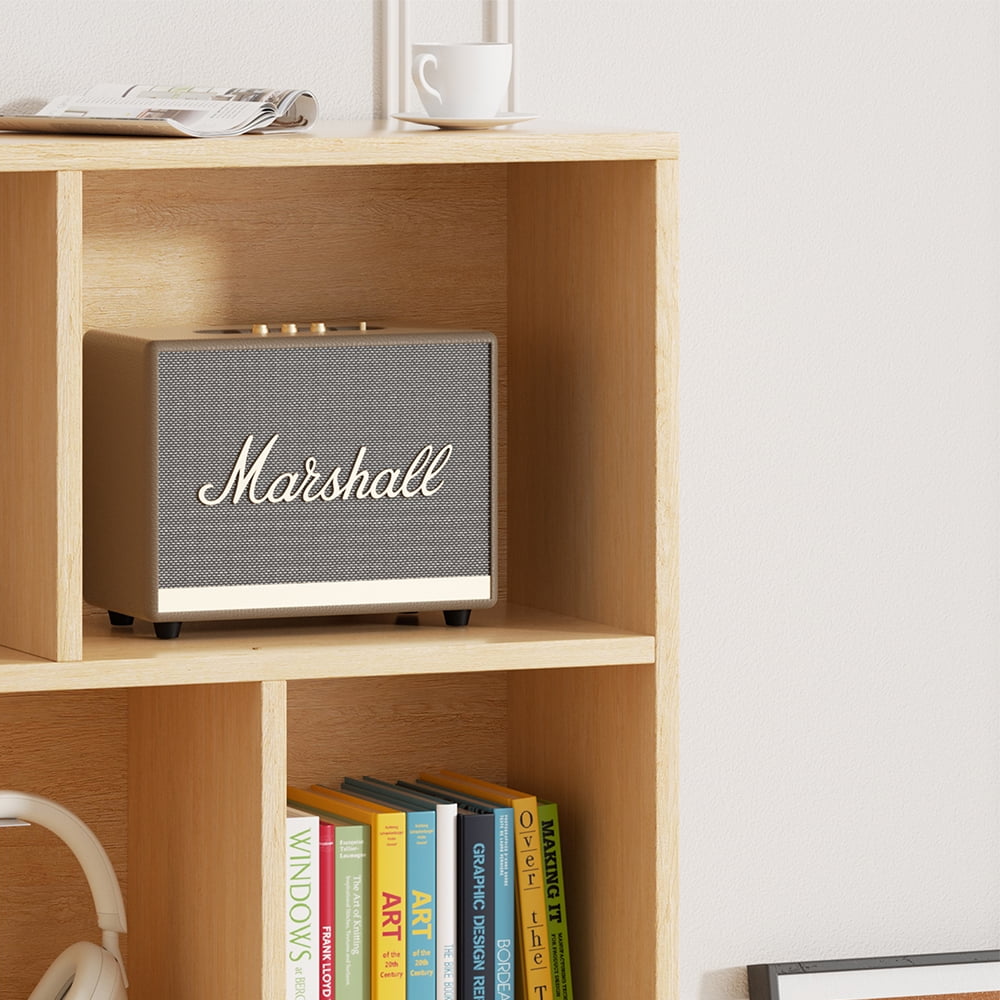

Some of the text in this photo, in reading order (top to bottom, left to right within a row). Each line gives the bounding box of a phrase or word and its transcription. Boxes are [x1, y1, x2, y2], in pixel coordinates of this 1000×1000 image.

[198, 434, 454, 505] Marshall
[289, 828, 311, 962] WINDOWS
[473, 843, 485, 910] GRAPHIC
[541, 820, 562, 923] MAKING IT
[351, 874, 362, 955] The Art of Knitting
[382, 891, 401, 941] ART
[411, 889, 432, 940] ART
[322, 926, 332, 961] FRANK
[384, 960, 399, 968] 20th
[444, 944, 454, 958] THE
[473, 915, 485, 970] DESIGN
[322, 963, 332, 997] LLOYD
[380, 971, 403, 979] Century
[410, 969, 433, 977] Century
